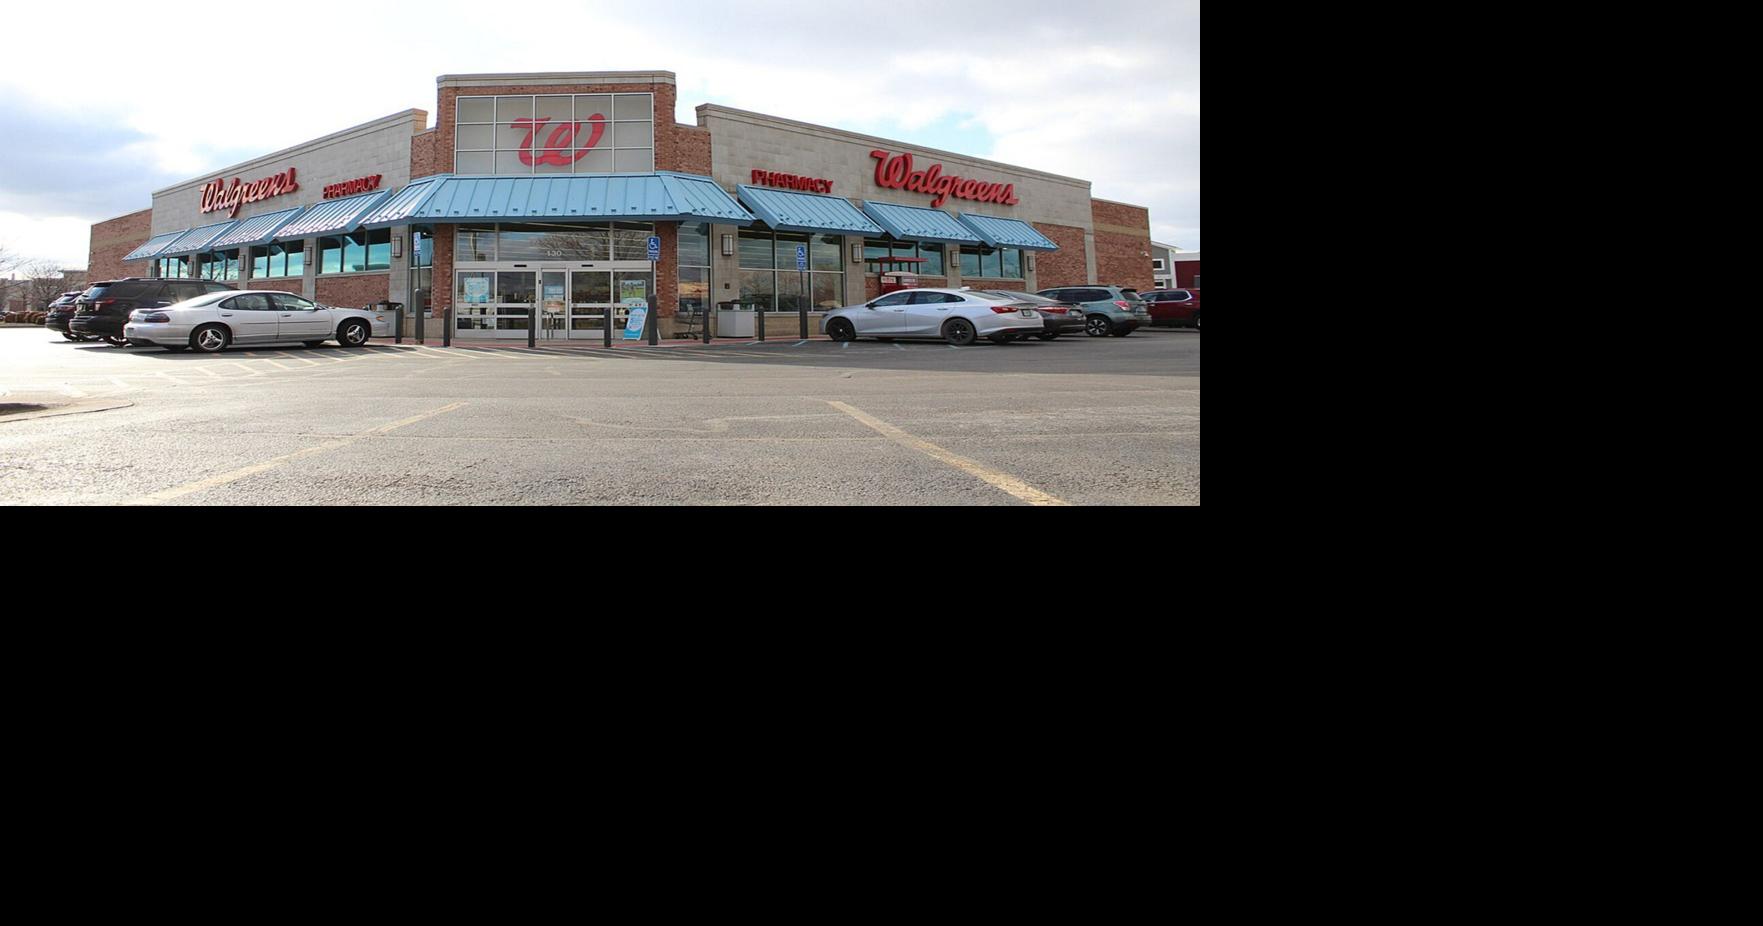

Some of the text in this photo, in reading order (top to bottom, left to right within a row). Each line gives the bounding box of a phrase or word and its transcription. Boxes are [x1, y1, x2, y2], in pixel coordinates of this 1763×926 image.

[200, 166, 299, 218] Walgreens
[323, 173, 382, 199] PHARMACY
[751, 168, 834, 194] PHARMACY
[869, 150, 1019, 208] Walgreens
